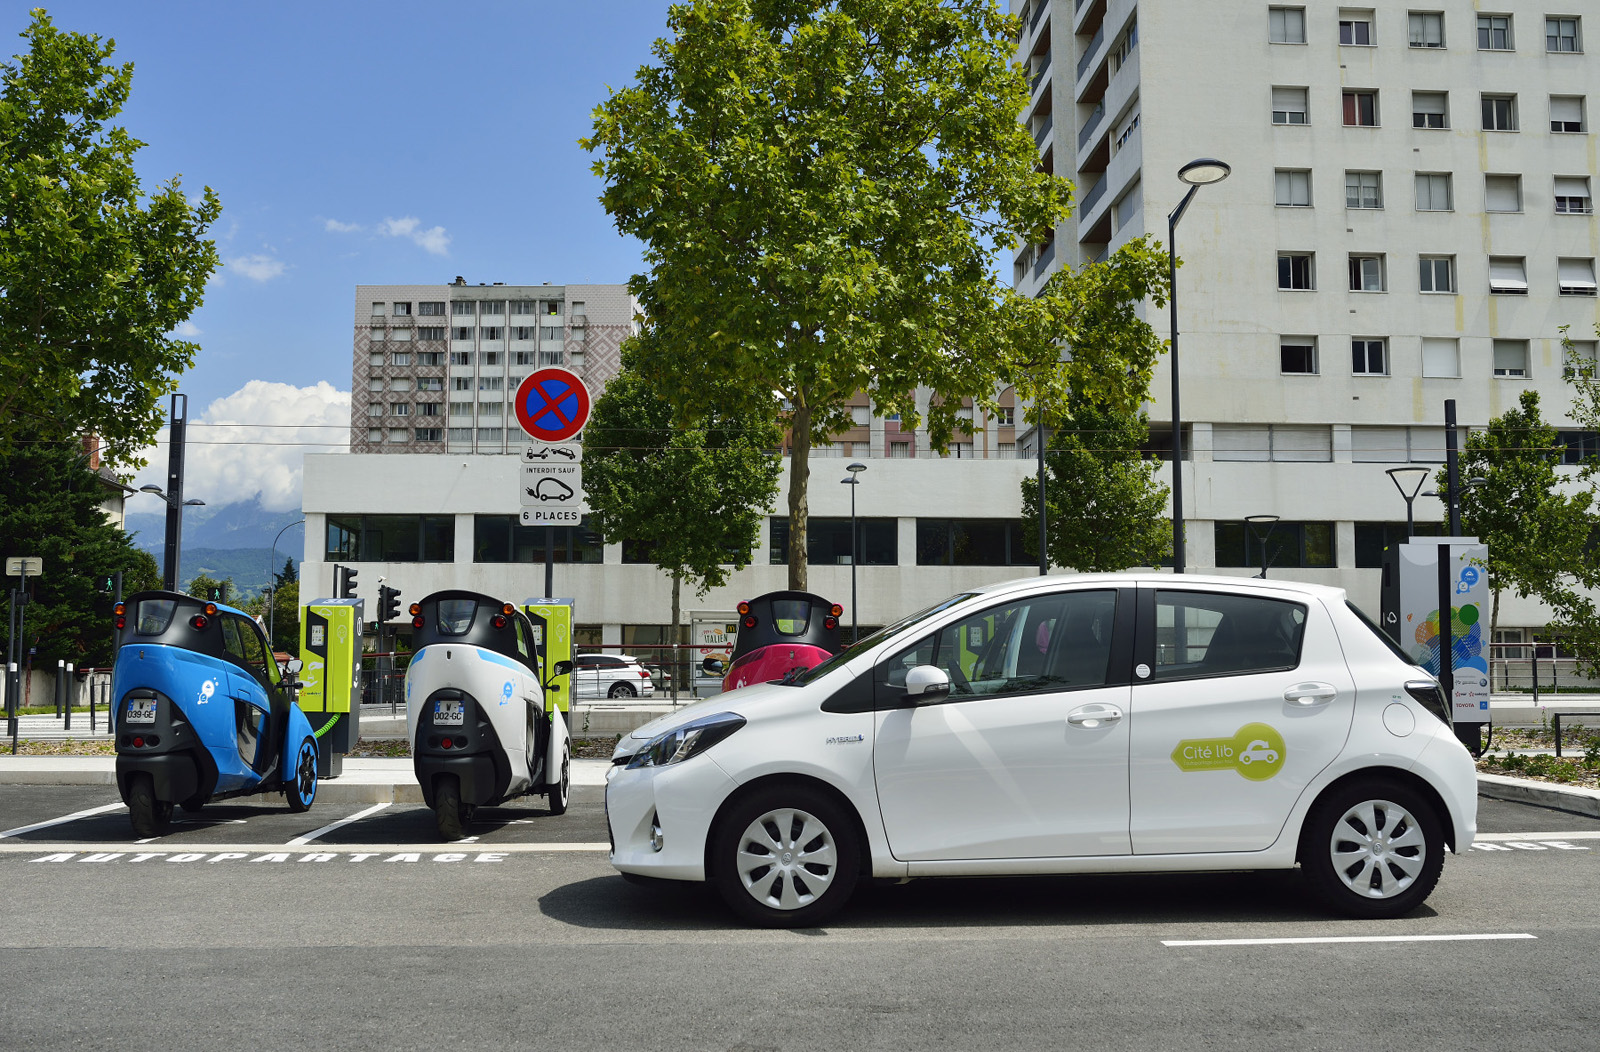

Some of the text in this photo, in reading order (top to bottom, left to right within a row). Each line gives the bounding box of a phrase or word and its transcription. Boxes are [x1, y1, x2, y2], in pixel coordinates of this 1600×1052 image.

[523, 511, 578, 520] 6 PLACES
[704, 634, 728, 644] ITALIEN
[127, 710, 154, 719] 039-GE
[434, 712, 462, 720] 002-GC
[1183, 744, 1234, 760] Cité lib
[28, 853, 510, 863] AUTOPARTAGE
